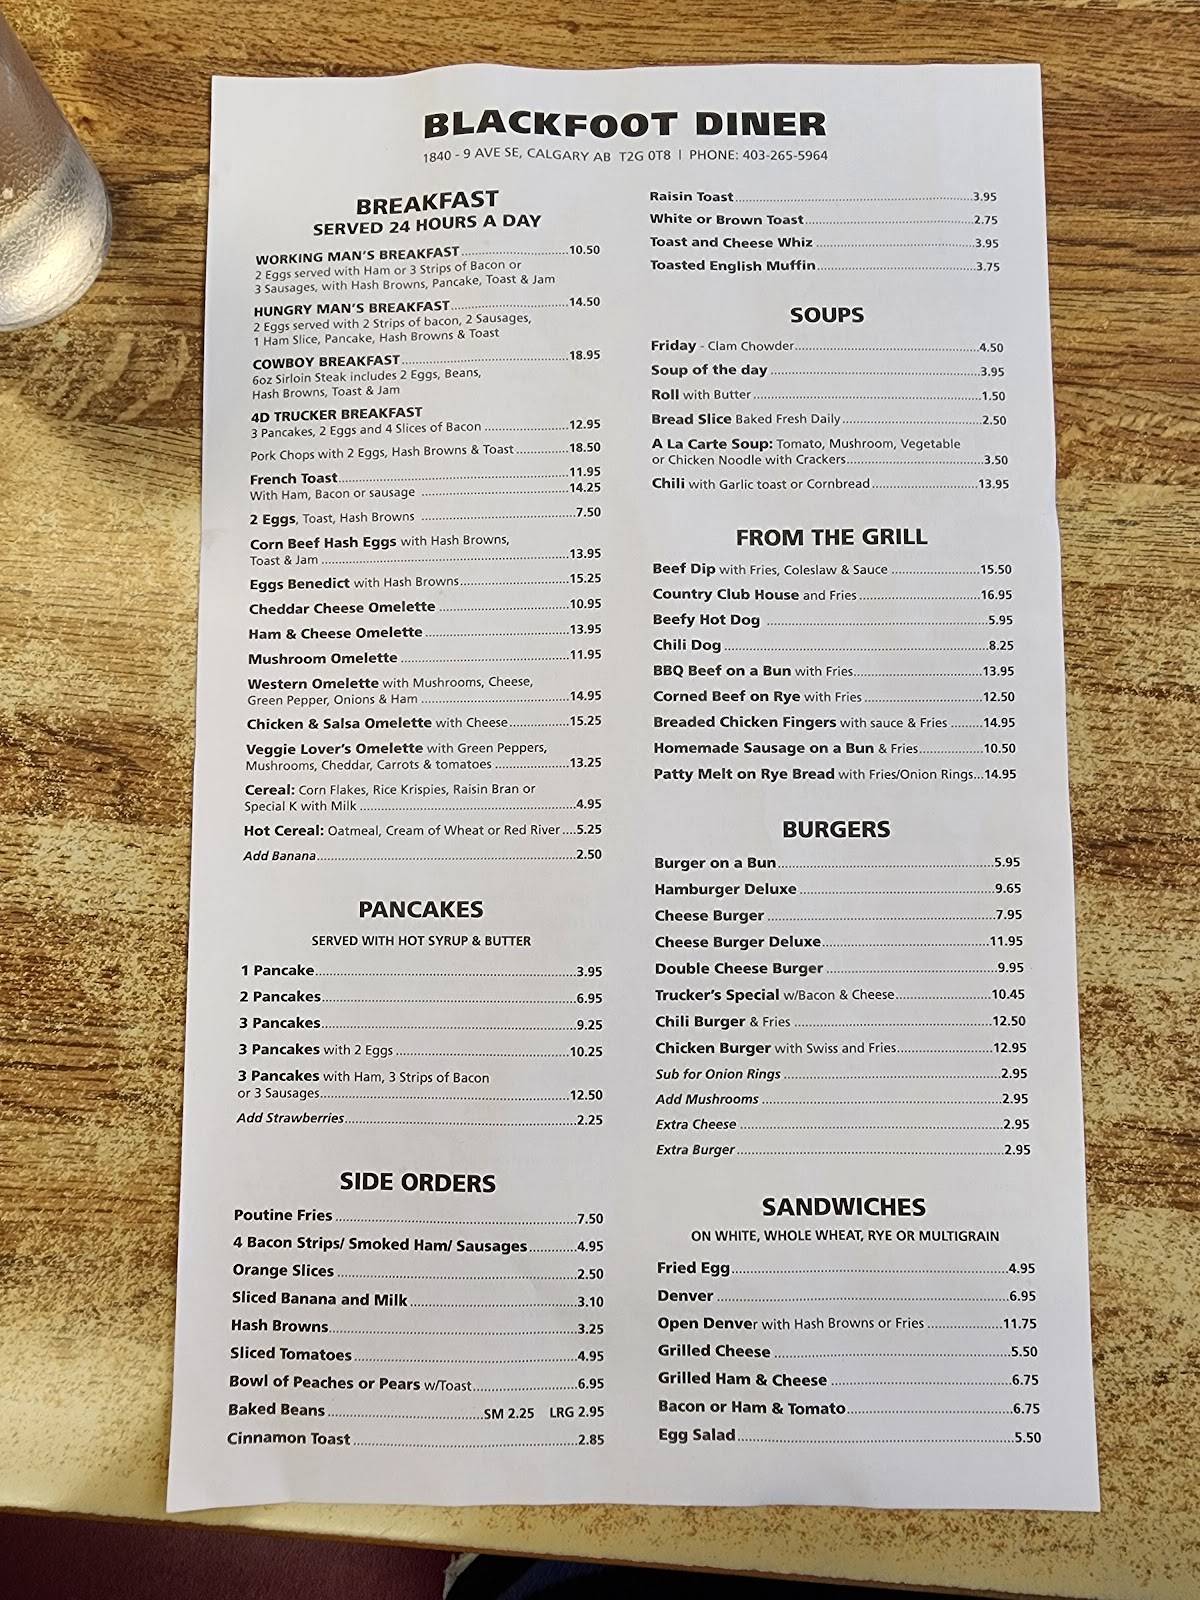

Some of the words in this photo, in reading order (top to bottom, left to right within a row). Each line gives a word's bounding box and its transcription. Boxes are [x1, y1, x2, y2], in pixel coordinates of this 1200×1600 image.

[424, 109, 678, 139] BLACKFOOT
[696, 111, 826, 136] DINER
[424, 150, 452, 163] 1840
[463, 148, 471, 159] 9
[474, 147, 500, 158] AVE
[505, 147, 522, 159] SE,
[527, 148, 589, 161] CALGARY
[593, 152, 611, 162] AB
[619, 151, 644, 162] T2G
[648, 150, 671, 161] 0T8
[690, 149, 738, 160] PHONE:
[742, 149, 828, 161] 403-265-5964
[356, 190, 499, 215] BREAKFAST
[650, 191, 692, 201] Raisin
[696, 192, 734, 202] Toast
[973, 192, 997, 202] 3.95
[313, 222, 383, 236] SERVED
[389, 220, 411, 234] 24
[416, 215, 477, 232] HOURS
[483, 215, 497, 228] A
[503, 214, 542, 228] DAY
[256, 252, 323, 265] WORKING
[379, 246, 460, 260] BREAKFAST
[569, 245, 600, 255] 10.50
[650, 260, 705, 271] Toasted
[710, 260, 762, 274] English
[766, 259, 816, 271] Muffin
[977, 262, 1000, 272] 3.75
[255, 284, 261, 294] 3
[265, 284, 318, 295] Sausages,
[321, 280, 347, 291] with
[351, 280, 379, 290] Hash
[383, 280, 428, 290] Browns,
[432, 276, 482, 288] Pancake,
[485, 274, 516, 284] Toast
[520, 274, 528, 284] &
[532, 275, 555, 285] Jam
[790, 307, 864, 323] SOUPS
[252, 357, 315, 370] COWBOY
[319, 354, 400, 367] BREAKFAST
[569, 350, 600, 360] 18.95
[252, 375, 272, 385] 6oz
[276, 372, 311, 384] Sirloin
[315, 372, 347, 383] Steak
[350, 370, 397, 381] includes
[400, 370, 407, 380] 2
[411, 369, 440, 382] Eggs,
[445, 369, 481, 378] Beans,
[652, 413, 694, 425] Bread
[698, 413, 732, 425] Slice
[736, 413, 772, 424] Baked
[776, 413, 807, 424] Fresh
[811, 413, 841, 426] Daily
[982, 415, 1007, 425] 2.50
[250, 473, 297, 485] French
[300, 472, 338, 484] Toast
[570, 466, 601, 477] 11.95
[652, 477, 685, 489] Chili
[688, 479, 715, 490] with
[719, 479, 754, 490] Garlic
[756, 480, 787, 490] toast
[790, 481, 803, 489] or
[807, 478, 870, 489] Cornbread
[979, 479, 1009, 489] 13.95
[250, 539, 284, 550] Corn
[288, 537, 320, 549] Beef
[324, 536, 358, 548] Hash
[363, 536, 397, 550] Eggs
[401, 536, 427, 546] with
[431, 534, 459, 546] Hash
[463, 535, 509, 546] Browns,
[737, 529, 804, 546] FROM
[811, 528, 854, 546] THE
[862, 528, 928, 545] GRILL
[653, 588, 713, 603] Country
[717, 588, 750, 600] Club
[755, 589, 799, 600] House
[803, 590, 825, 601] and
[830, 590, 857, 600] Fries
[981, 589, 1012, 600] 16.95
[249, 603, 310, 615] Cheddar
[313, 602, 364, 614] Cheese
[368, 600, 436, 613] Omelette
[570, 598, 601, 609] 10.95
[246, 743, 296, 758] Veggie
[356, 742, 423, 754] Omelette
[427, 743, 454, 754] with
[457, 743, 493, 753] Green
[497, 743, 547, 755] Peppers,
[654, 768, 694, 783] Patty
[698, 768, 733, 780] Melt
[737, 771, 756, 779] on
[761, 768, 788, 783] Rye
[792, 768, 835, 780] Bread
[838, 769, 865, 780] with
[869, 769, 937, 780] Fries/Onion
[941, 769, 974, 782] Rings
[985, 769, 1016, 779] 14.95
[783, 820, 890, 838] BURGERS
[242, 850, 270, 861] Add
[272, 851, 316, 861] Banana
[576, 849, 602, 860] 2.50
[359, 900, 483, 918] PANCAKES
[312, 935, 358, 946] SERVED
[361, 935, 394, 946] WITH
[398, 935, 425, 946] HOT
[428, 935, 468, 946] SYRUP
[472, 935, 481, 946] &
[485, 936, 531, 946] BUTTER
[240, 991, 249, 1002] 2
[253, 990, 321, 1002] Pancakes
[577, 993, 602, 1004] 6.95
[726, 988, 779, 1004] Special
[783, 990, 835, 1000] w/Bacon
[839, 989, 848, 1000] &
[852, 989, 895, 1000] Cheese
[992, 989, 1025, 1000] 10.45
[236, 1112, 264, 1123] Add
[265, 1112, 345, 1124] Strawberries
[577, 1114, 603, 1125] 2.25
[340, 1172, 393, 1191] SIDE
[401, 1173, 496, 1193] ORDERS
[762, 1197, 926, 1216] SANDWICHES
[234, 1208, 293, 1221] Poutine
[297, 1209, 333, 1221] Fries
[577, 1213, 604, 1224] 7.50
[691, 1230, 711, 1242] ON
[714, 1230, 760, 1243] WHITE,
[764, 1230, 812, 1241] WHOLE
[815, 1229, 864, 1242] WHEAT,
[868, 1230, 892, 1241] RYE
[896, 1230, 915, 1241] OR
[919, 1230, 999, 1242] MULTIGRAIN
[228, 1402, 276, 1416] Baked
[281, 1403, 325, 1417] Beans
[484, 1408, 504, 1420] SM
[508, 1407, 534, 1419] 2.25
[550, 1406, 574, 1418] LRG
[578, 1406, 604, 1417] 2.95
[227, 1431, 306, 1445] Cinnamon
[310, 1432, 351, 1446] Toast
[578, 1434, 605, 1445] 2.85
[659, 1428, 688, 1444] Egg
[693, 1428, 735, 1441] Salad
[1015, 1432, 1041, 1443] 5.50
